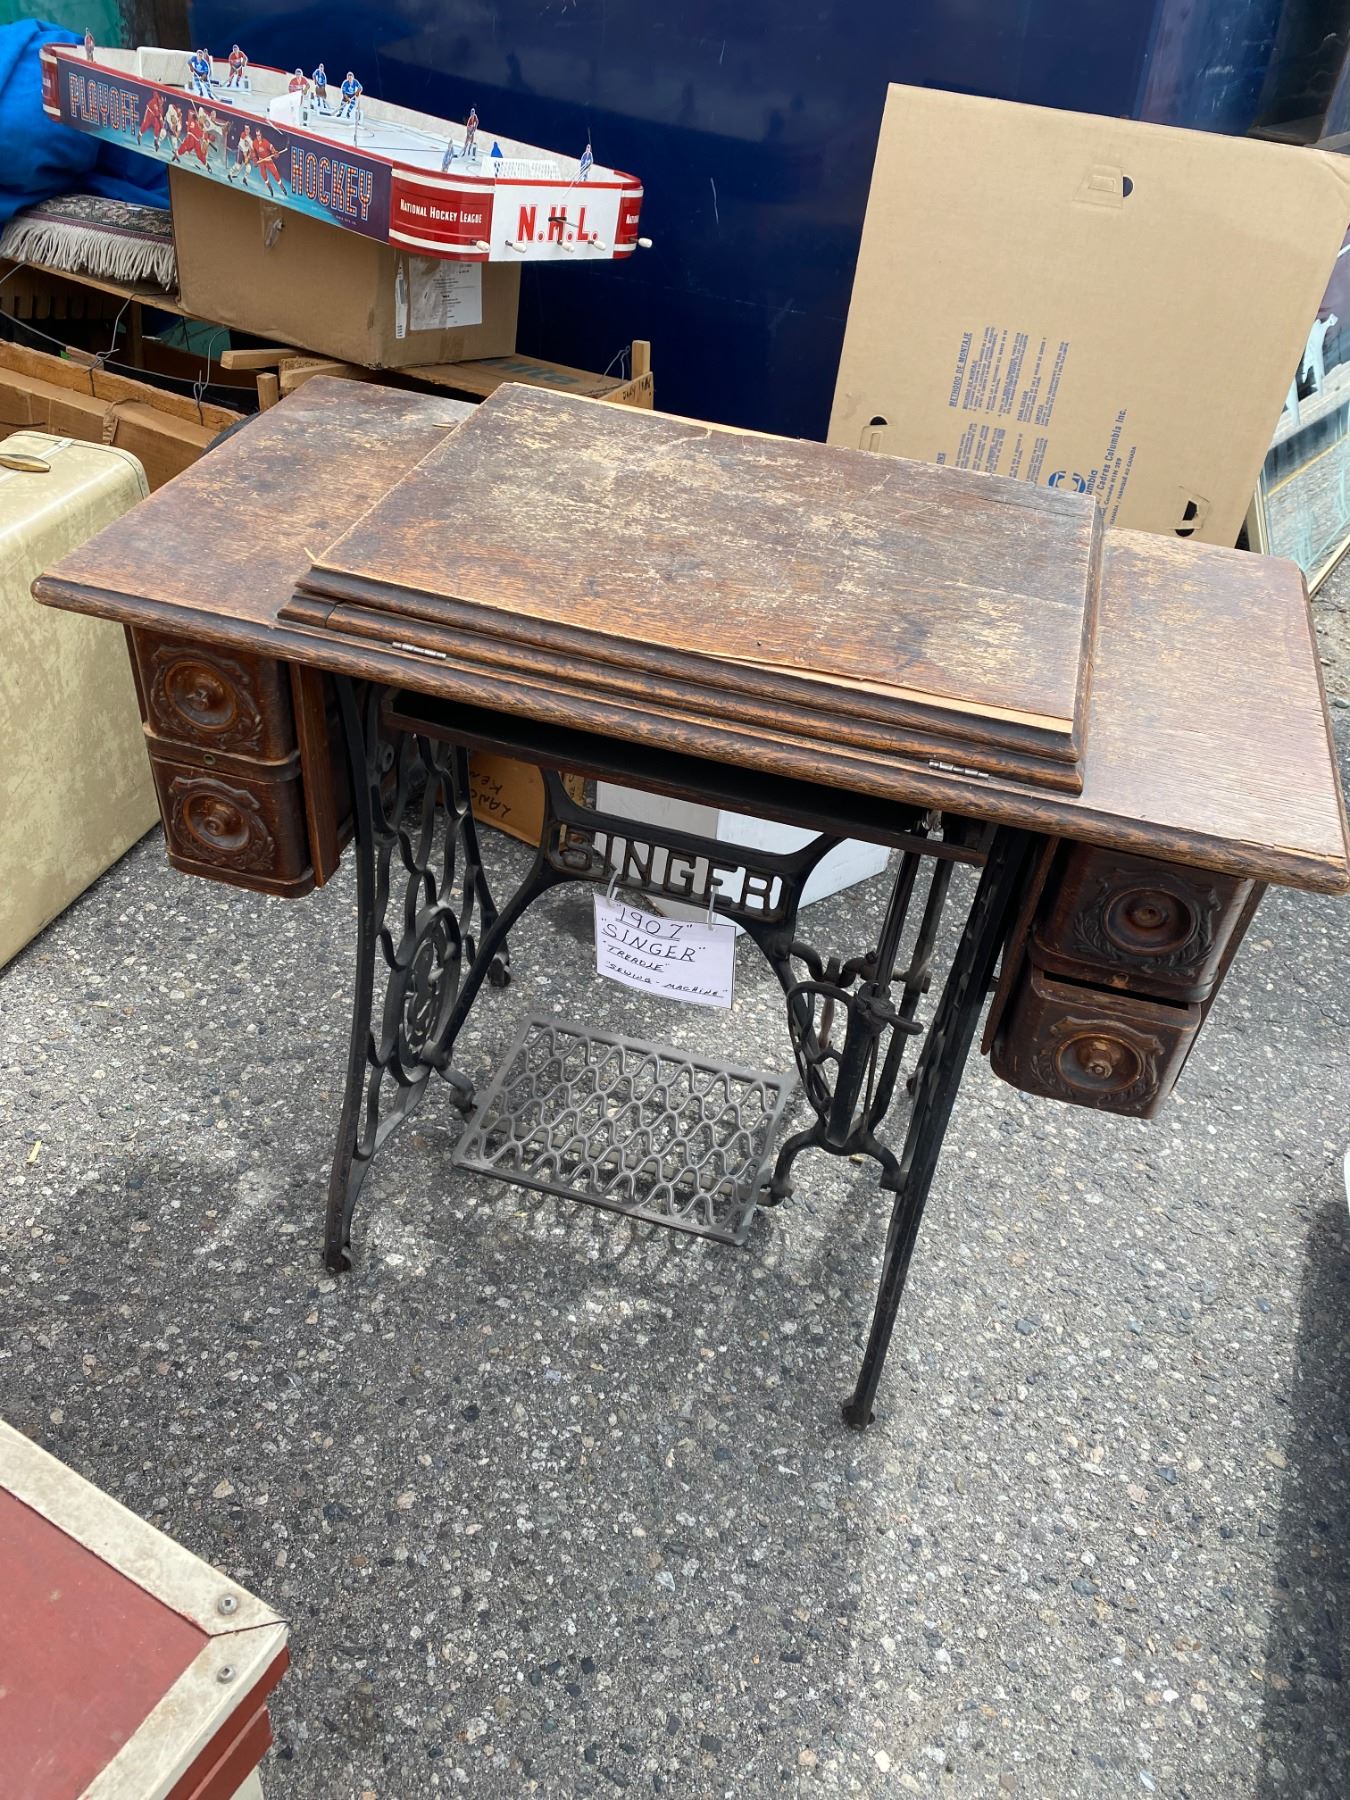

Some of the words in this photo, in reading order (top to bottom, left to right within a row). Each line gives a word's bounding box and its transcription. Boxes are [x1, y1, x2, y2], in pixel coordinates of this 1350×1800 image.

[69, 72, 139, 136] PLAYOFF
[291, 146, 373, 221] HOCKEY
[400, 198, 427, 216] NATIONAL
[430, 206, 457, 222] HOCKEY
[460, 211, 482, 223] LEAGUE
[516, 204, 599, 243] N.H.L.
[958, 331, 972, 363] MONTAJE
[1097, 463, 1111, 490] Cadres
[1104, 425, 1122, 461] Columbia
[1115, 408, 1128, 423] Inc.
[1127, 446, 1136, 467] CANADA
[560, 827, 775, 916] SINGER
[601, 918, 706, 963] "SINGER"
[615, 903, 693, 941] "1907"
